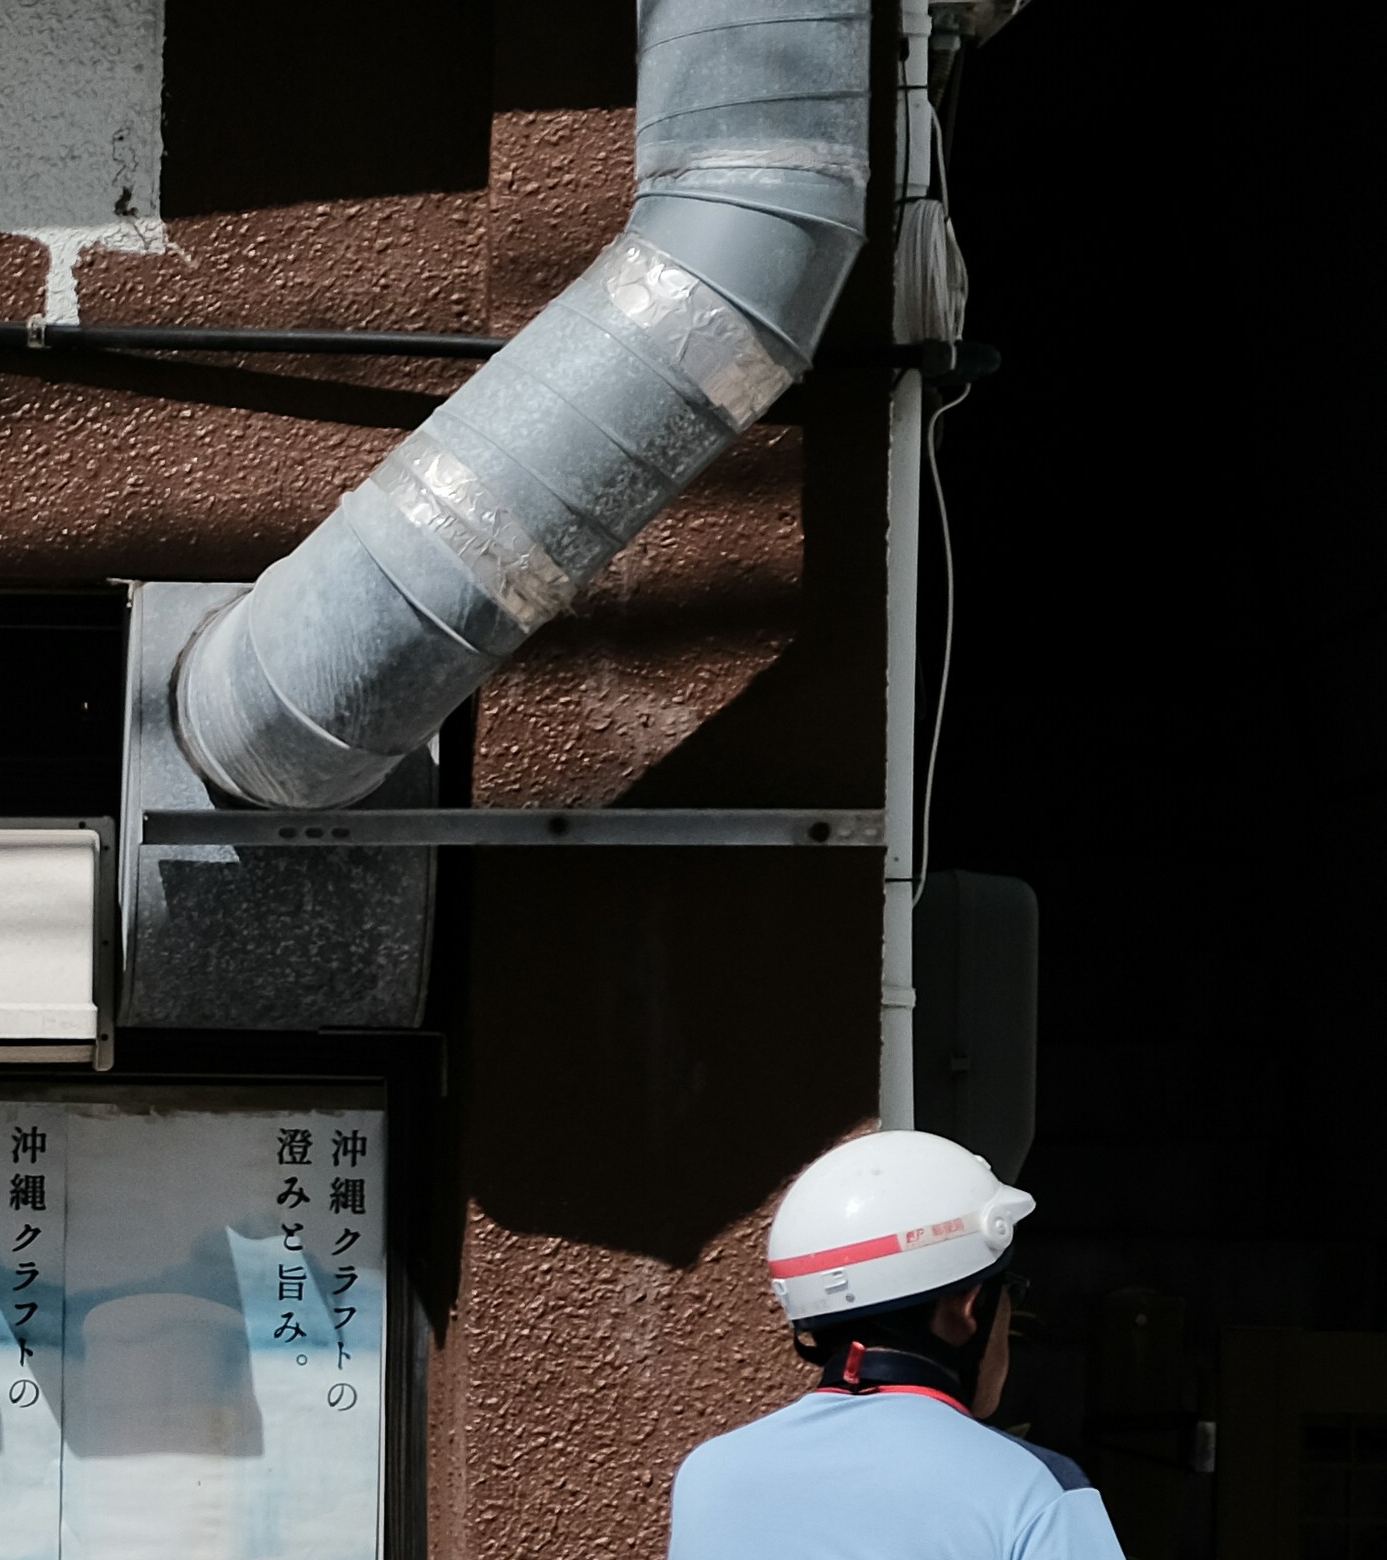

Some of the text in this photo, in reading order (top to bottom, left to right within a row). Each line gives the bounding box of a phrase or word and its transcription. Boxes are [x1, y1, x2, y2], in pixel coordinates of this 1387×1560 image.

[8, 1124, 48, 1408] 沖縄クラフトの
[272, 1128, 313, 1367] 澄みと旨み。
[326, 1129, 368, 1412] 沖縄クラフトの
